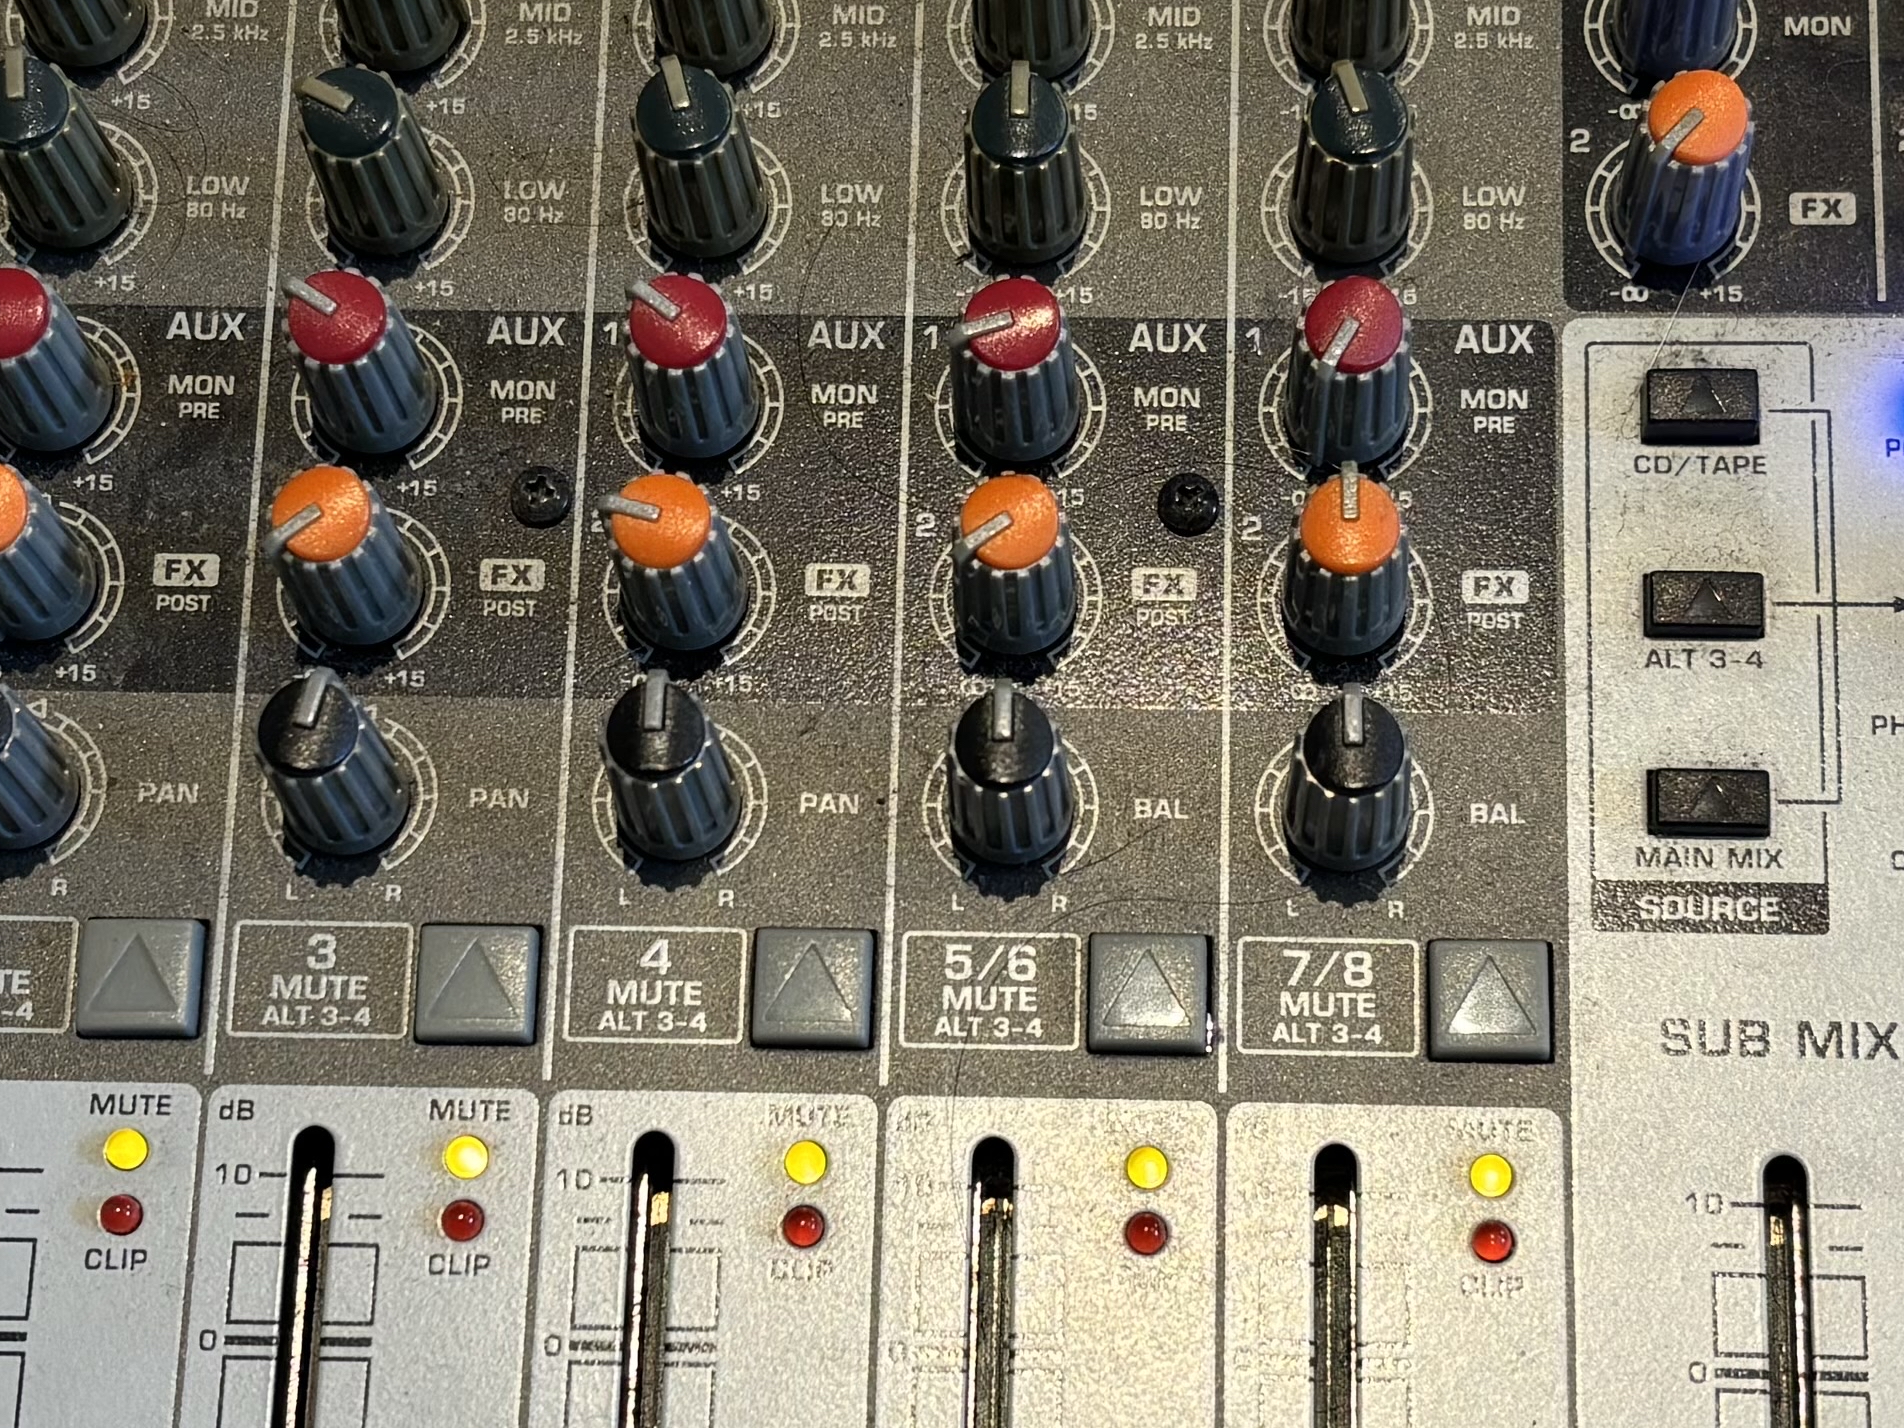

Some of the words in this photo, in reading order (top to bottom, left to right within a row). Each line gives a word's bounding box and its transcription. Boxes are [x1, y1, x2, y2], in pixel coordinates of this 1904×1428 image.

[1147, 6, 1201, 27] MID
[1466, 6, 1520, 27] MID
[1784, 14, 1852, 38] MON
[1135, 33, 1169, 49] 2.5
[1177, 33, 1213, 49] kHz
[1140, 187, 1202, 207] LOW
[1462, 186, 1526, 206] LOW
[1801, 197, 1842, 220] FX
[1140, 212, 1166, 229] 80
[1174, 212, 1201, 229] Hz
[1454, 326, 1534, 355] AUX
[1460, 388, 1528, 410] MON
[1473, 416, 1515, 434] PRE
[1633, 455, 1767, 475] CD/TAPE
[1644, 649, 1695, 670] ALT
[1709, 650, 1764, 669] 3-4
[1469, 802, 1526, 825] BAL
[1635, 846, 1716, 869] MAIN
[1728, 848, 1783, 869] MIX
[1638, 896, 1783, 923] SOURCE
[944, 944, 1037, 982] 5/6
[942, 985, 1038, 1012] MUTE
[934, 1017, 985, 1038] ALT
[993, 1018, 1043, 1038] 3-4
[1661, 1018, 1769, 1058] SUB
[1797, 1020, 1900, 1061] MIX
